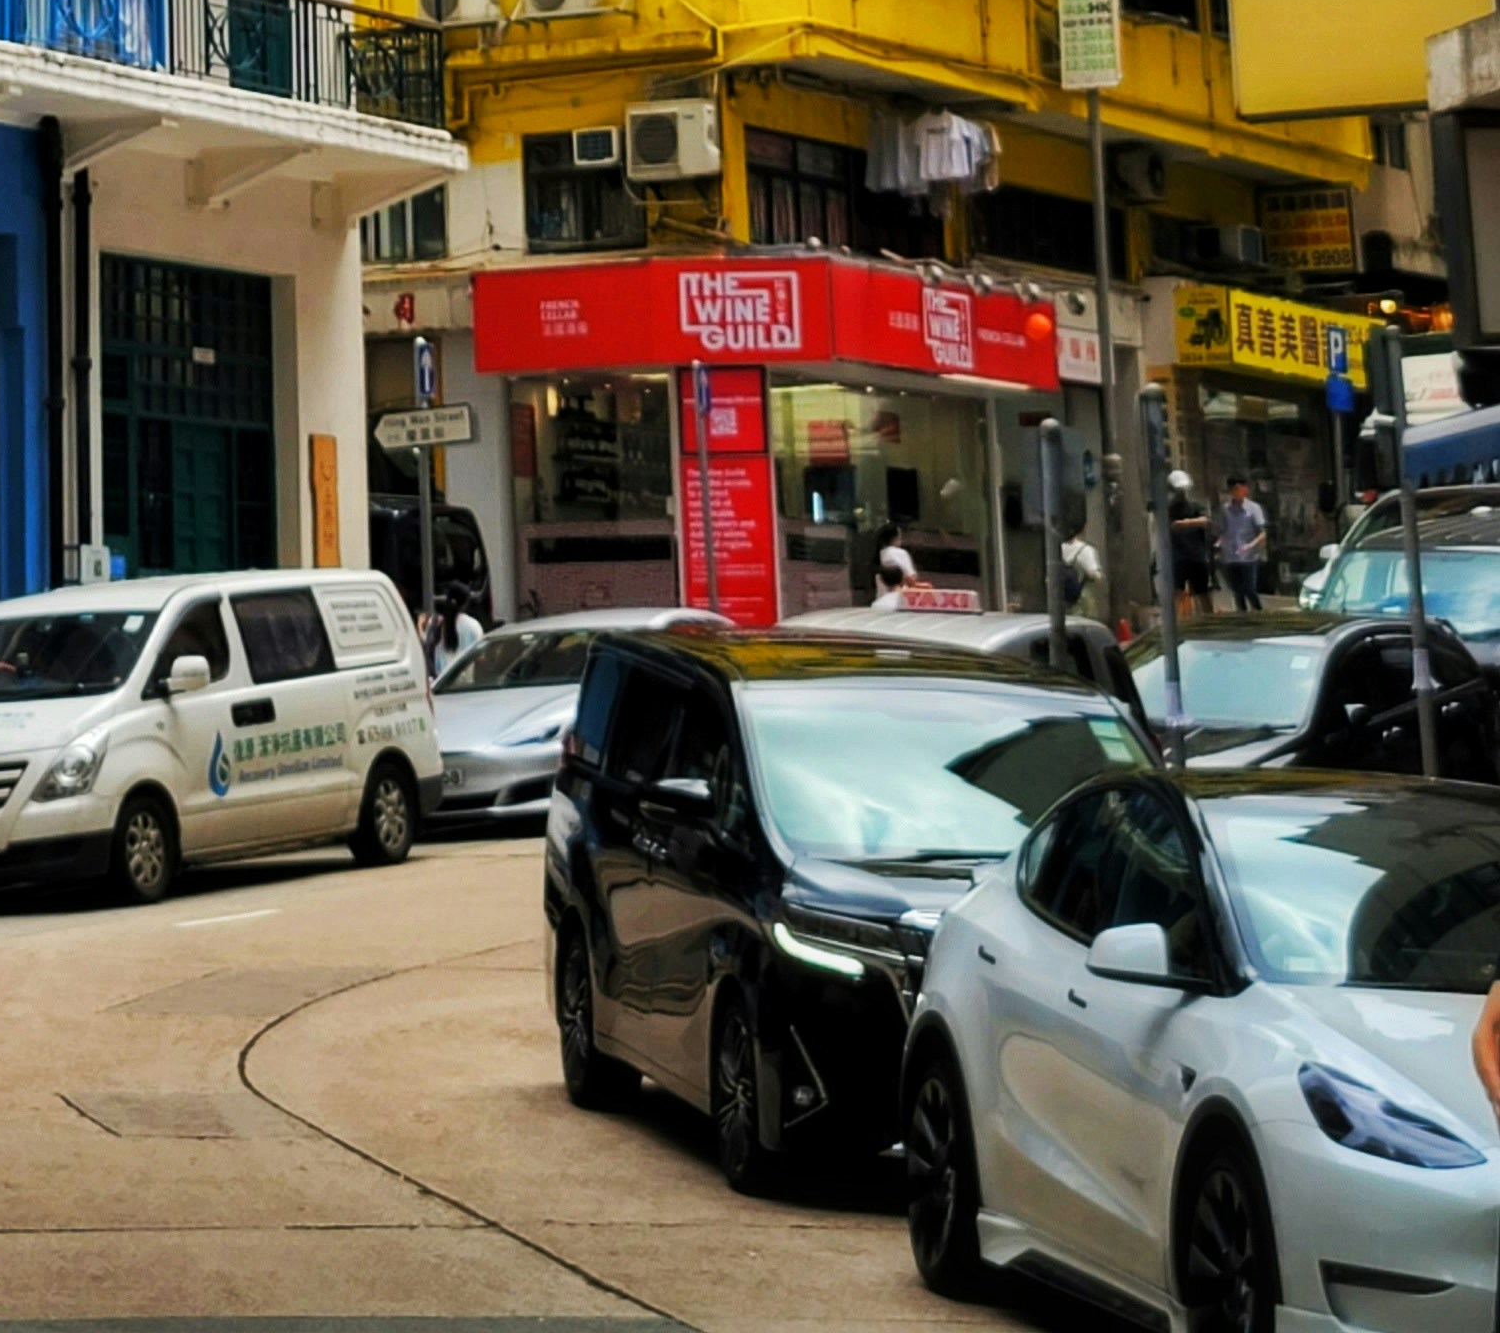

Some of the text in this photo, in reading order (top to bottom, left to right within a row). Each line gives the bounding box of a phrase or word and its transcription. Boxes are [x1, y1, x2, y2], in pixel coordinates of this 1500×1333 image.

[690, 271, 740, 296] THE
[692, 297, 769, 324] WINE
[700, 324, 798, 350] GUILD
[903, 592, 970, 607] TAXI
